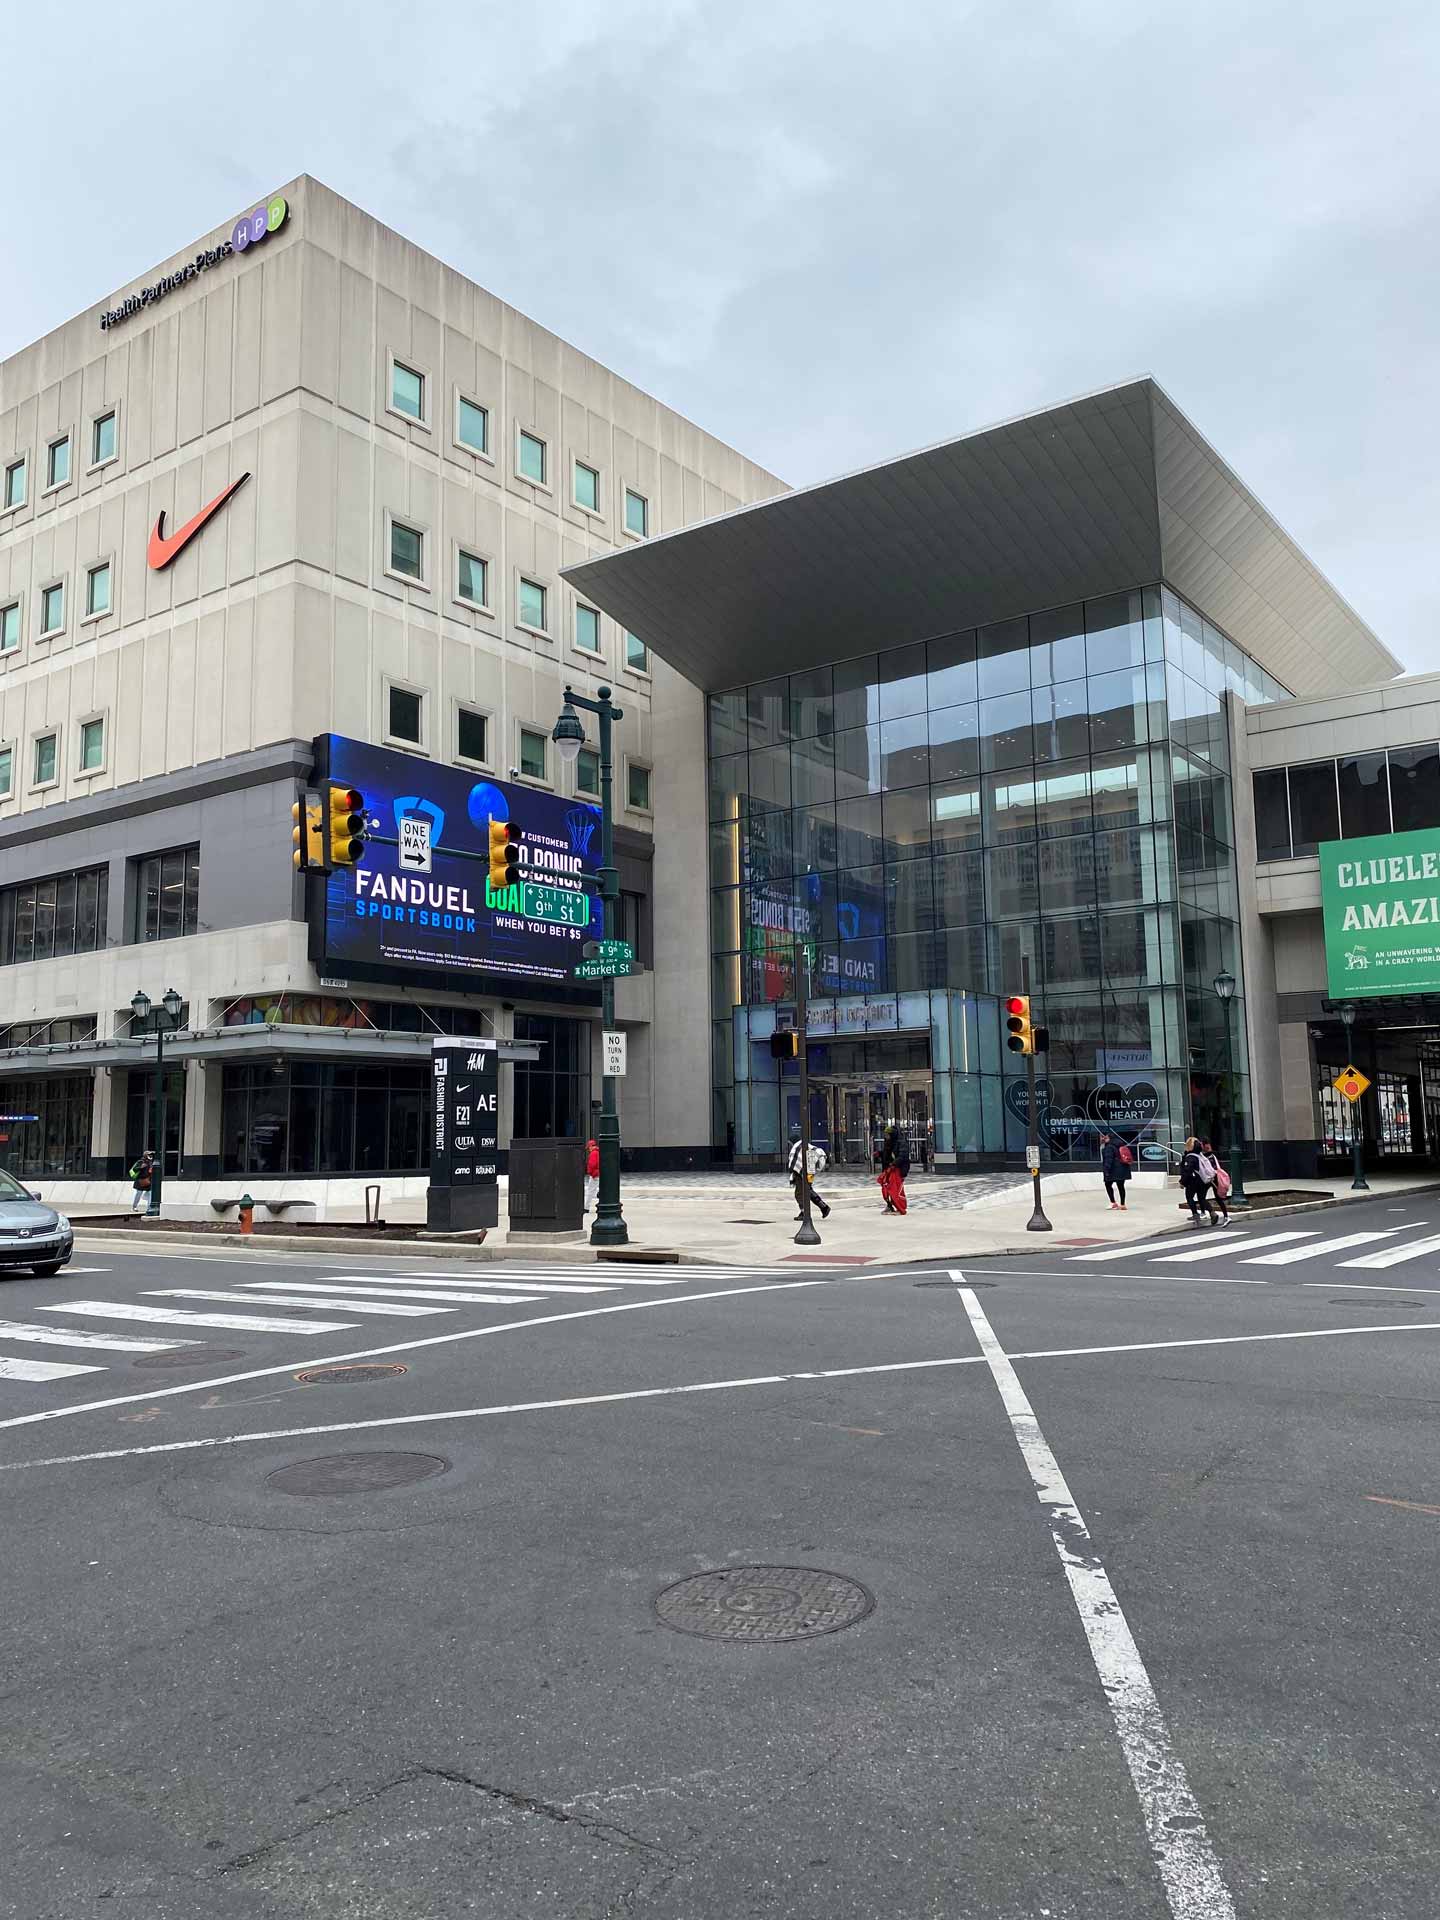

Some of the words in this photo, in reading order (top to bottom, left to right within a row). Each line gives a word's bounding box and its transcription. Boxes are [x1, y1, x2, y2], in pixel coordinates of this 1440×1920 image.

[100, 295, 144, 330] Health
[142, 263, 197, 304] Partners
[195, 241, 235, 272] Plans
[404, 823, 426, 837] ONE
[404, 836, 426, 850] WAY
[527, 832, 569, 849] CUSTOMERS
[1338, 852, 1440, 888] CLUELE
[355, 869, 475, 914] FANDUEL
[355, 899, 476, 933] SPORTSBOOK
[535, 900, 553, 916] 9th
[560, 905, 574, 922] St
[495, 916, 524, 931] WHEN
[527, 921, 547, 934] YOU
[549, 925, 567, 937] BET
[569, 927, 581, 940] $5
[623, 948, 632, 959] St
[1386, 947, 1433, 957] UNWAVERING
[1391, 956, 1414, 965] CRAZY
[582, 963, 617, 976] Market
[619, 963, 630, 973] St
[608, 1036, 620, 1045] NO
[607, 1046, 622, 1054] TURN
[466, 1052, 485, 1072] H&M
[609, 1065, 620, 1073] RED
[436, 1076, 445, 1112] FASHION
[476, 1094, 497, 1111] AE
[1098, 1099, 1132, 1109] PHILLY
[1134, 1099, 1157, 1108] GOT
[456, 1105, 470, 1121] F21
[1110, 1110, 1145, 1120] HEART
[1045, 1118, 1067, 1126] LOVE
[1070, 1117, 1083, 1125] UR
[435, 1113, 445, 1151] DISTRICT
[1050, 1126, 1079, 1135] STYLE
[457, 1136, 475, 1146] ULTA
[481, 1137, 496, 1146] DSW
[454, 1167, 471, 1175] amc
